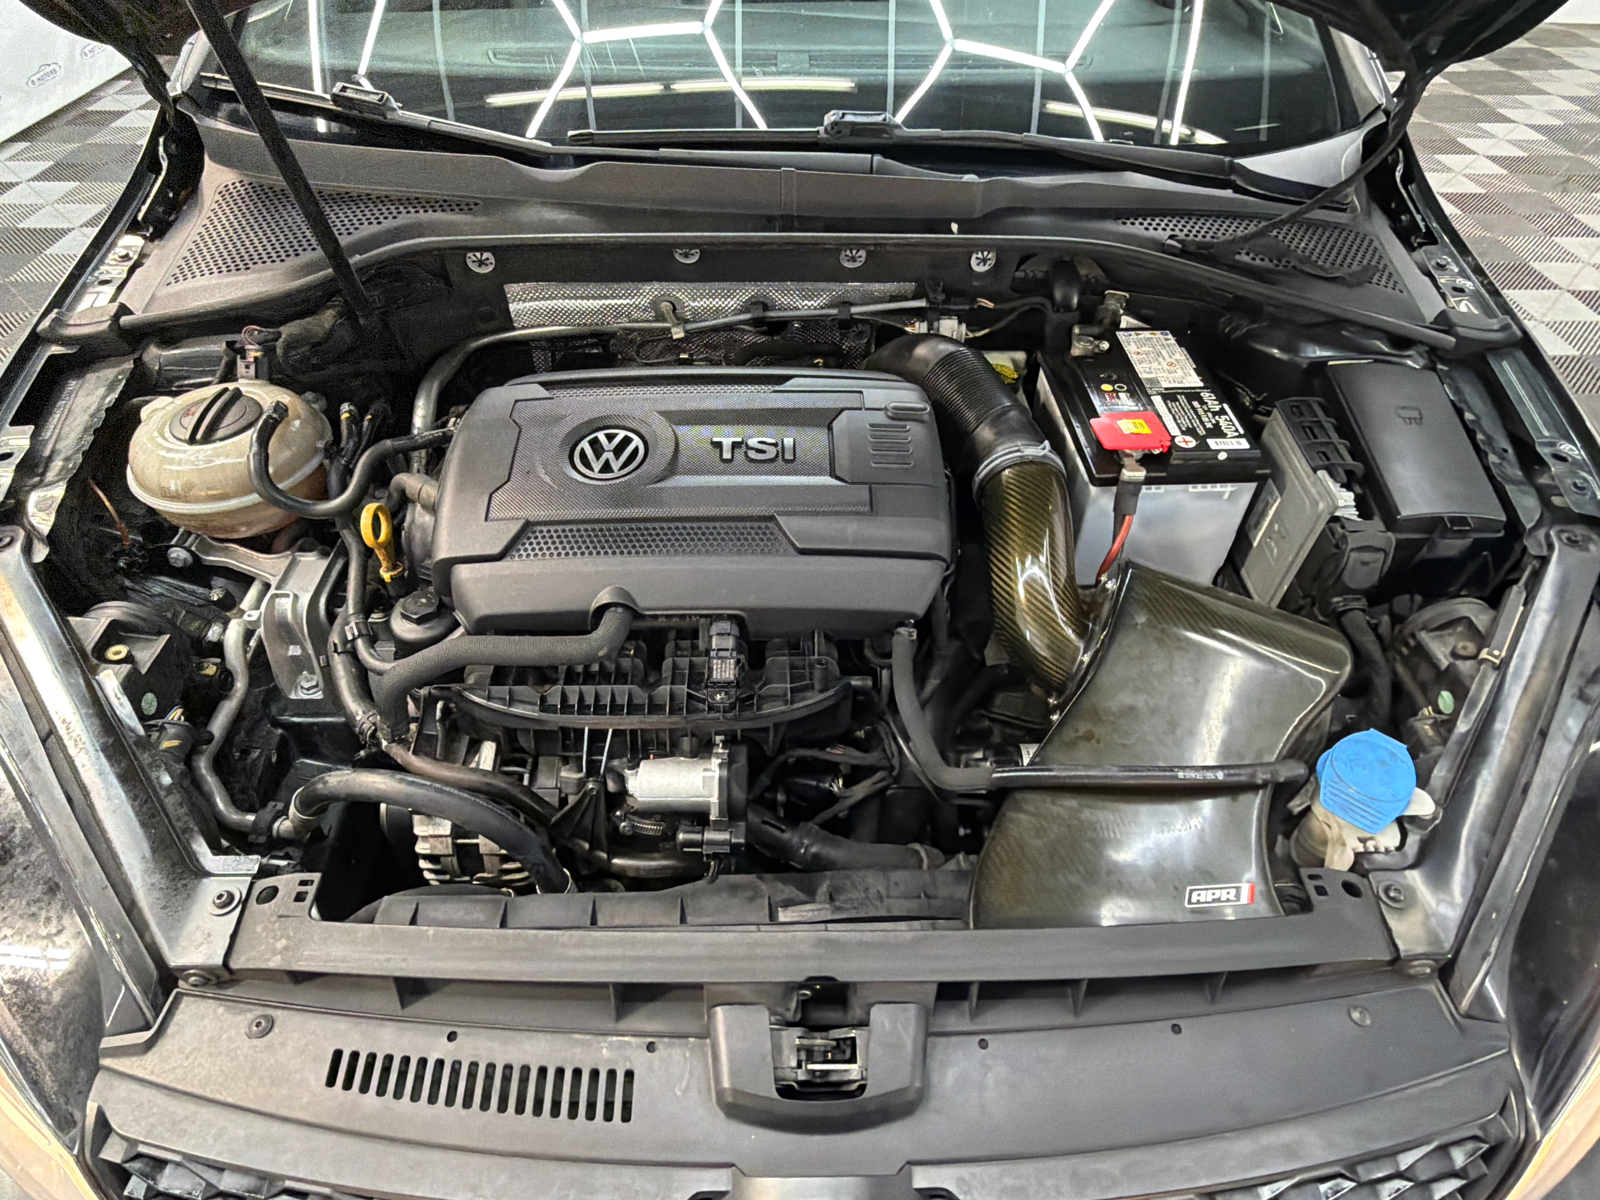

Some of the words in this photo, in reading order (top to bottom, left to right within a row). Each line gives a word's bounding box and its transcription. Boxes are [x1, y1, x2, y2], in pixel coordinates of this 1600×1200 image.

[1200, 392, 1222, 411] 61Ah
[1215, 415, 1239, 438] 540A
[711, 437, 795, 461] TSI
[1191, 888, 1237, 903] APR
